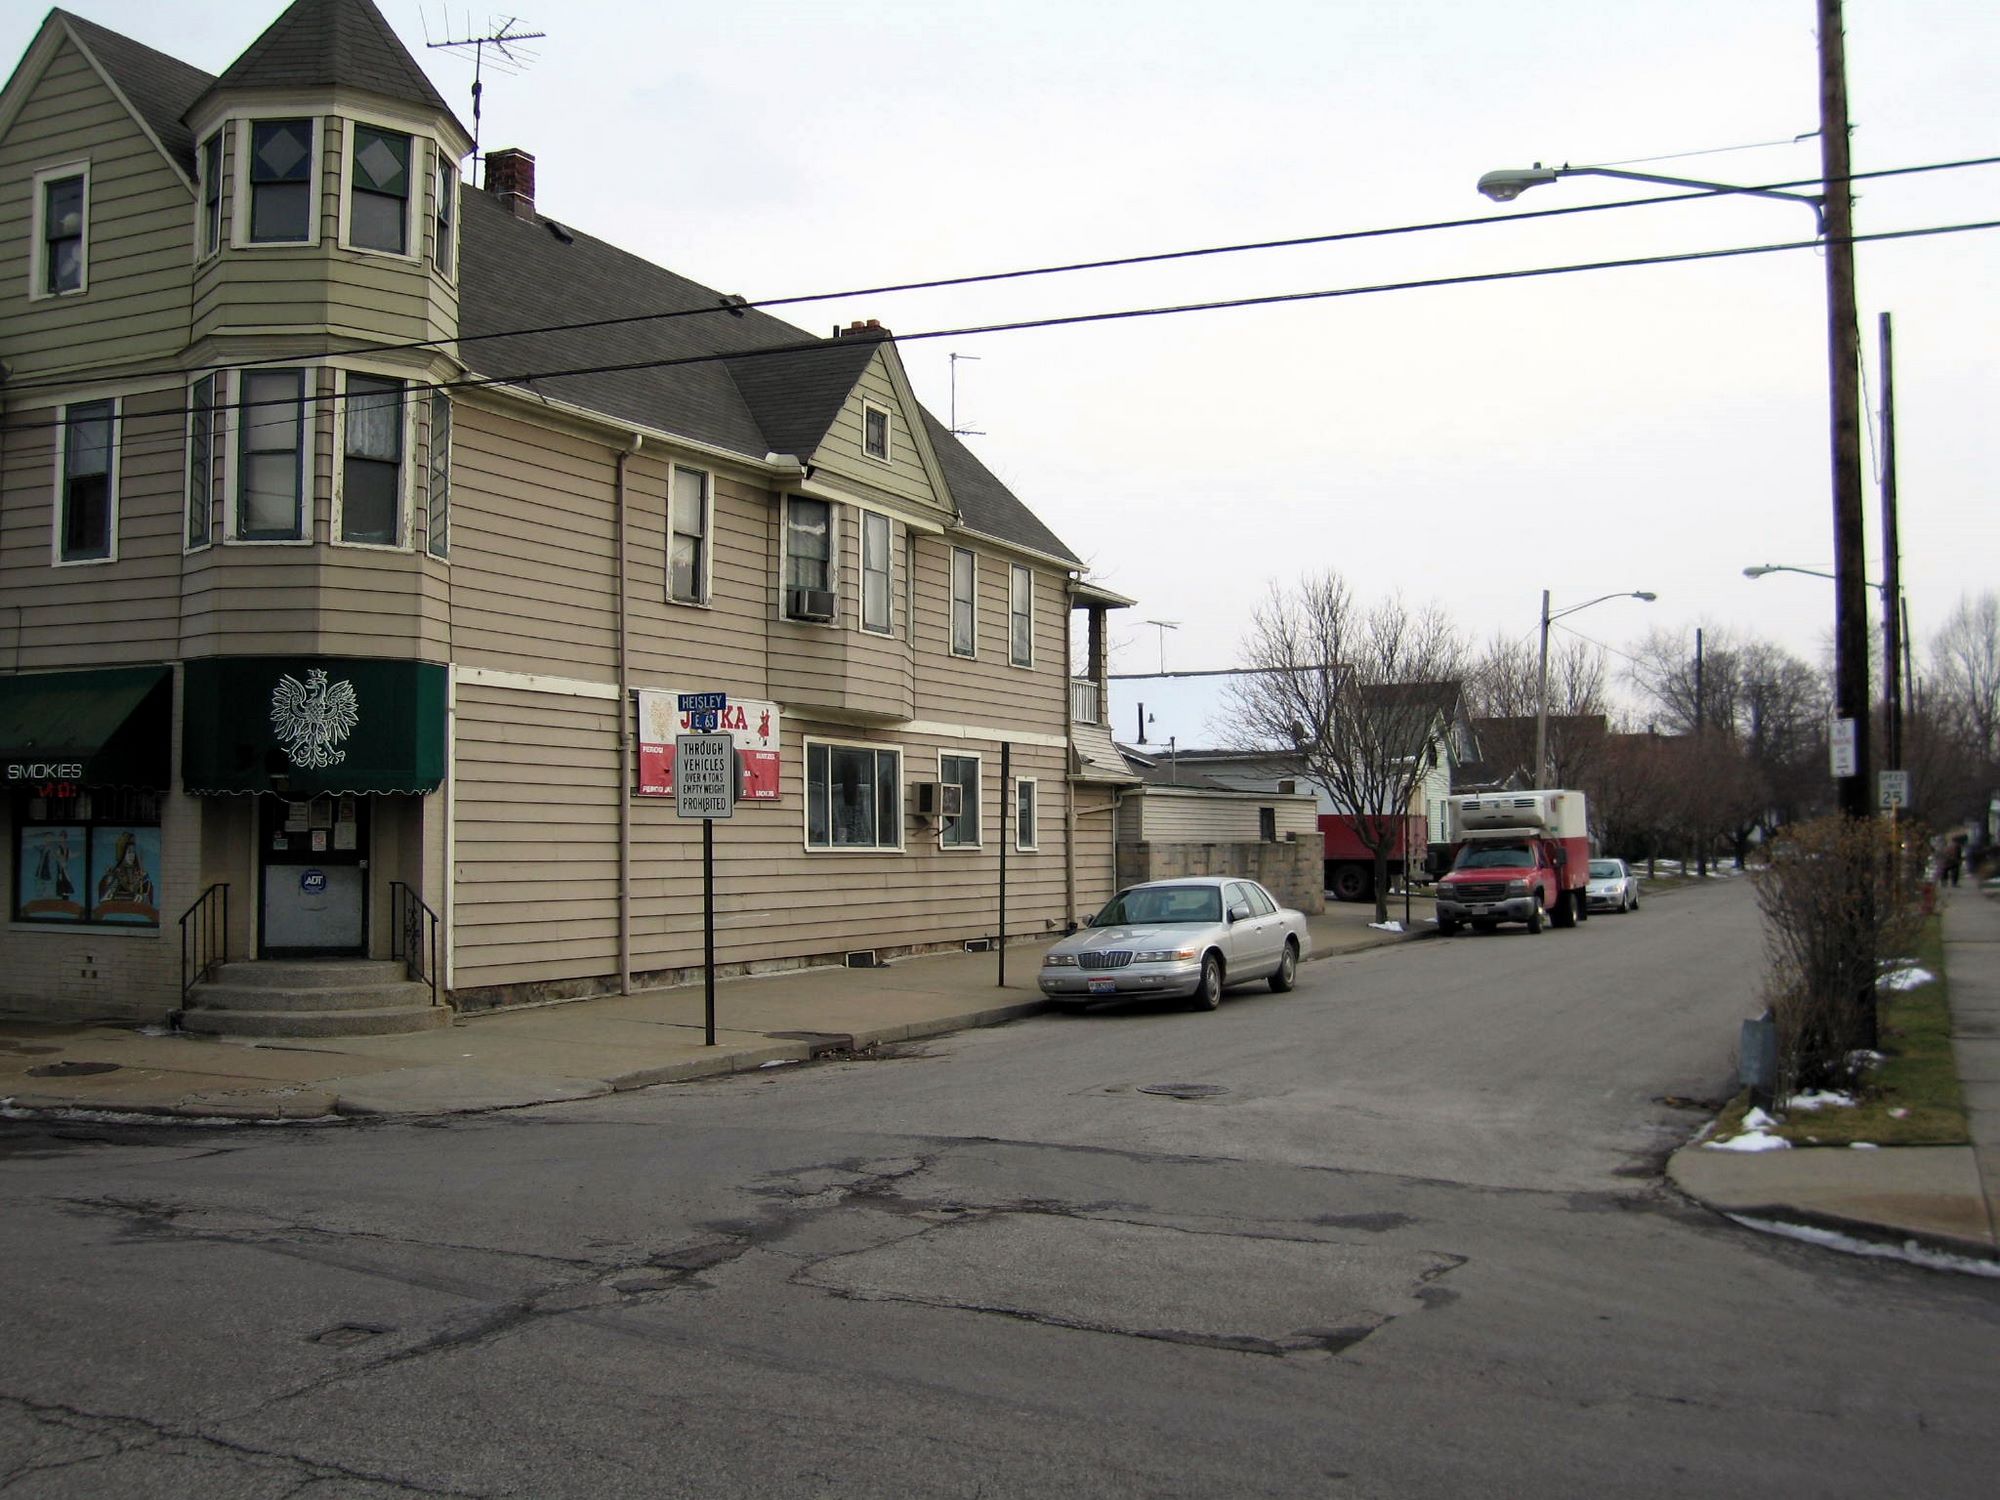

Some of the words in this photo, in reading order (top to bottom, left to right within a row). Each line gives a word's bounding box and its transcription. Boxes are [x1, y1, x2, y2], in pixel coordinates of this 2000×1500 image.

[682, 695, 722, 709] HEISLEY
[705, 714, 714, 727] 63
[684, 742, 723, 755] THROUGH
[8, 763, 82, 779] SMOKIES
[684, 759, 724, 771] VEHICLES
[685, 773, 701, 782] OVER
[708, 773, 723, 782] TONS
[683, 785, 703, 794] EMPTY
[704, 785, 725, 794] WEIGHT
[1883, 791, 1902, 804] 25
[683, 798, 726, 810] PROHIBITED
[304, 875, 323, 884] ADT
